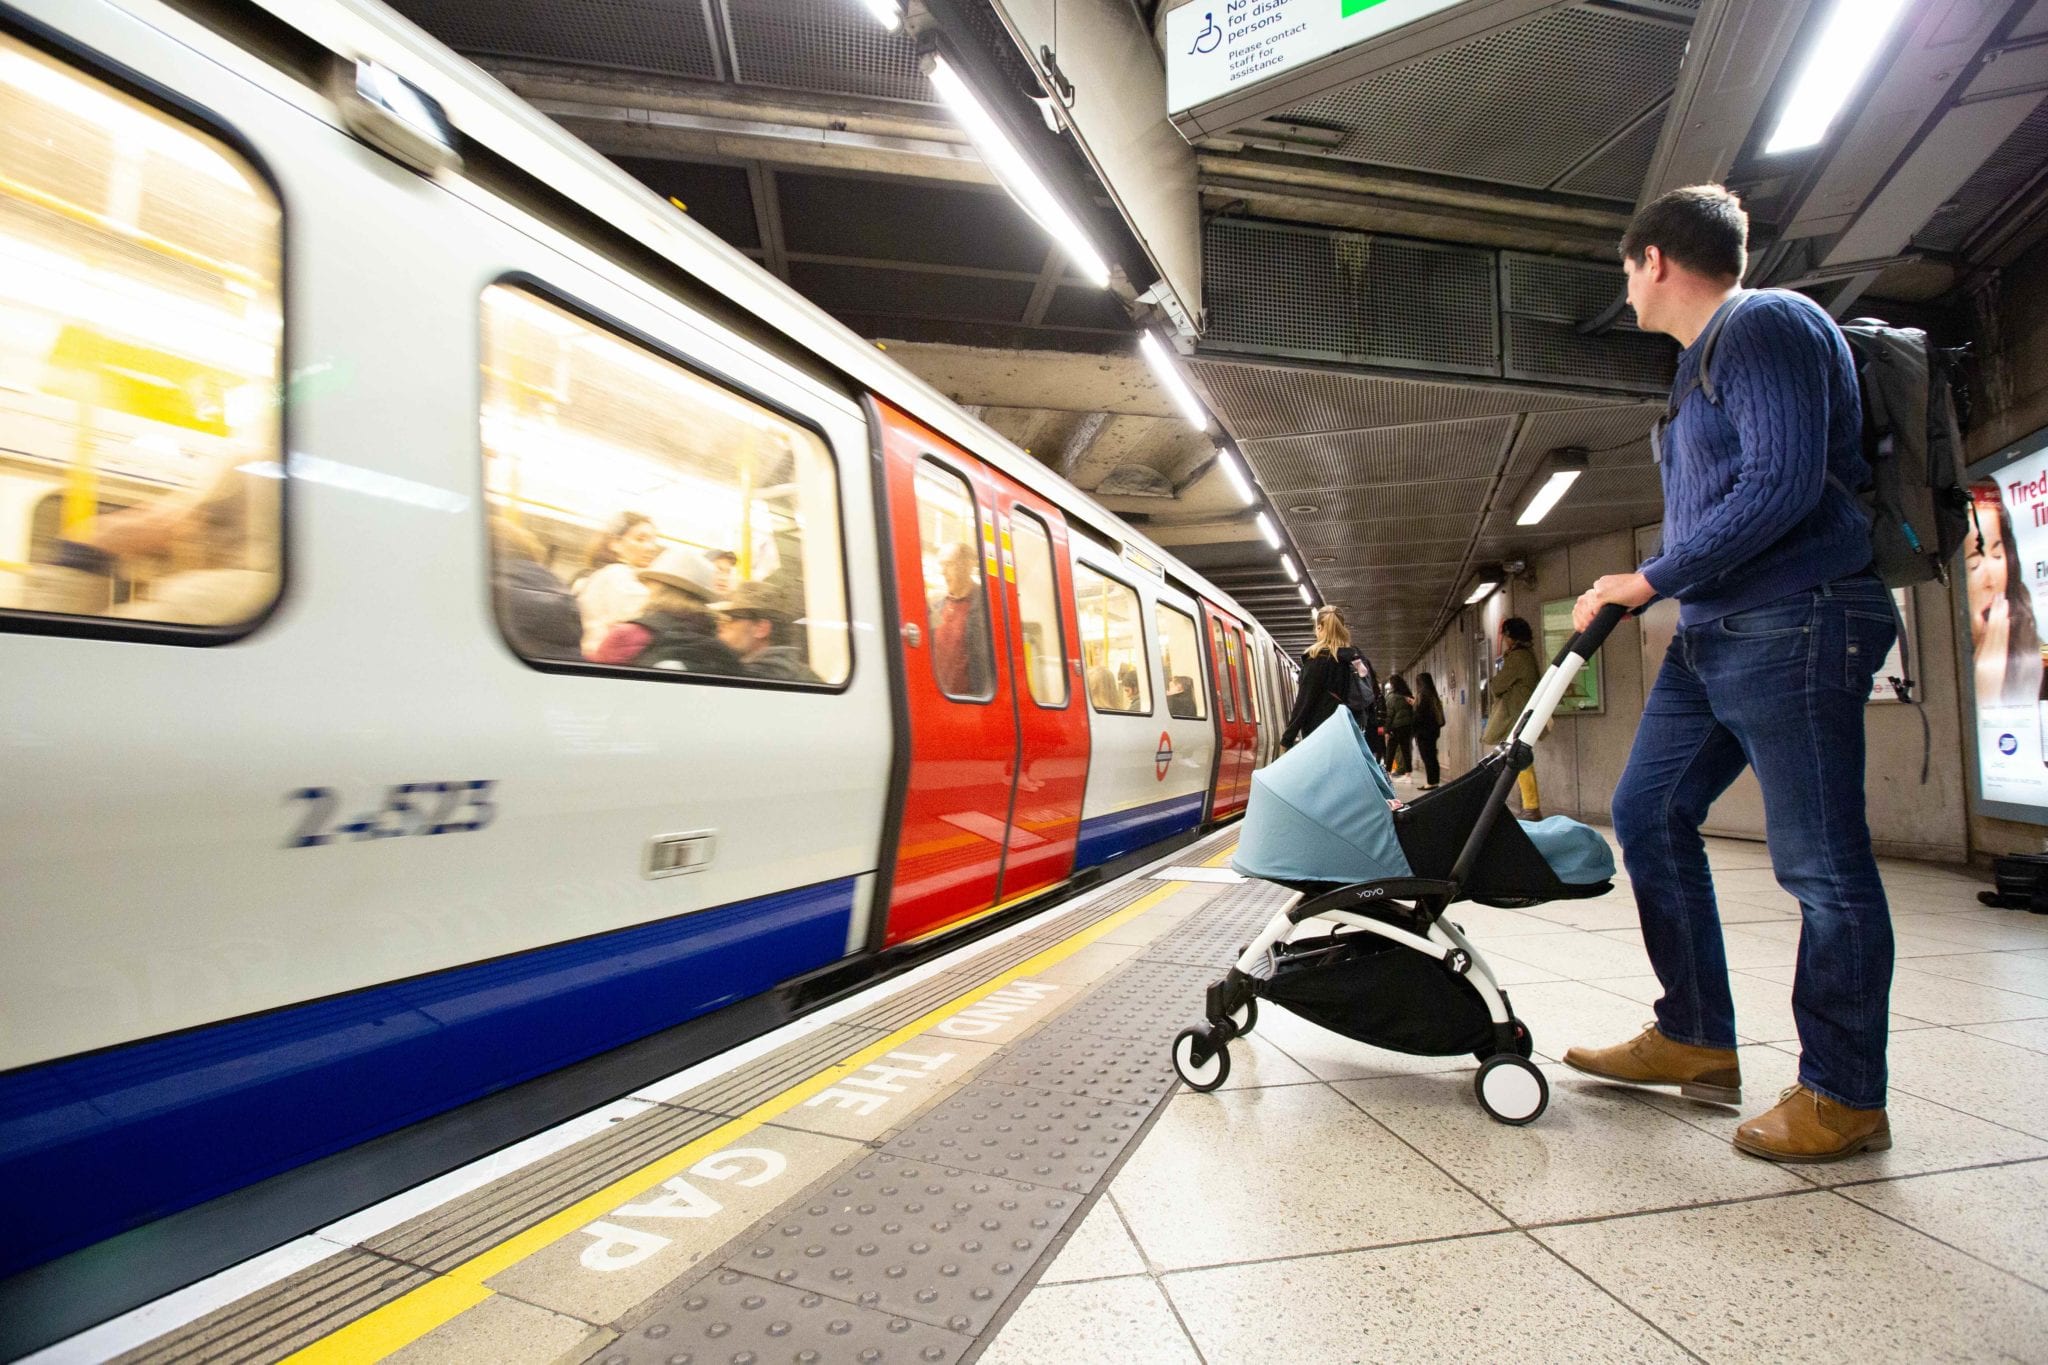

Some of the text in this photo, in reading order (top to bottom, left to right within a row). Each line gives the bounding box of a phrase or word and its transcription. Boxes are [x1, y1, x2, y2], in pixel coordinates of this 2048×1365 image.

[1227, 0, 1247, 14] No
[1228, 0, 1292, 27] for disab
[1228, 12, 1283, 44] persons
[1229, 22, 1307, 60] Please contact
[1229, 47, 1274, 70] staff for
[1230, 55, 1284, 81] assistance
[2008, 469, 2047, 506] Tired
[1356, 888, 1384, 899] YOYO
[579, 979, 1060, 1272] MIND THE GAP
